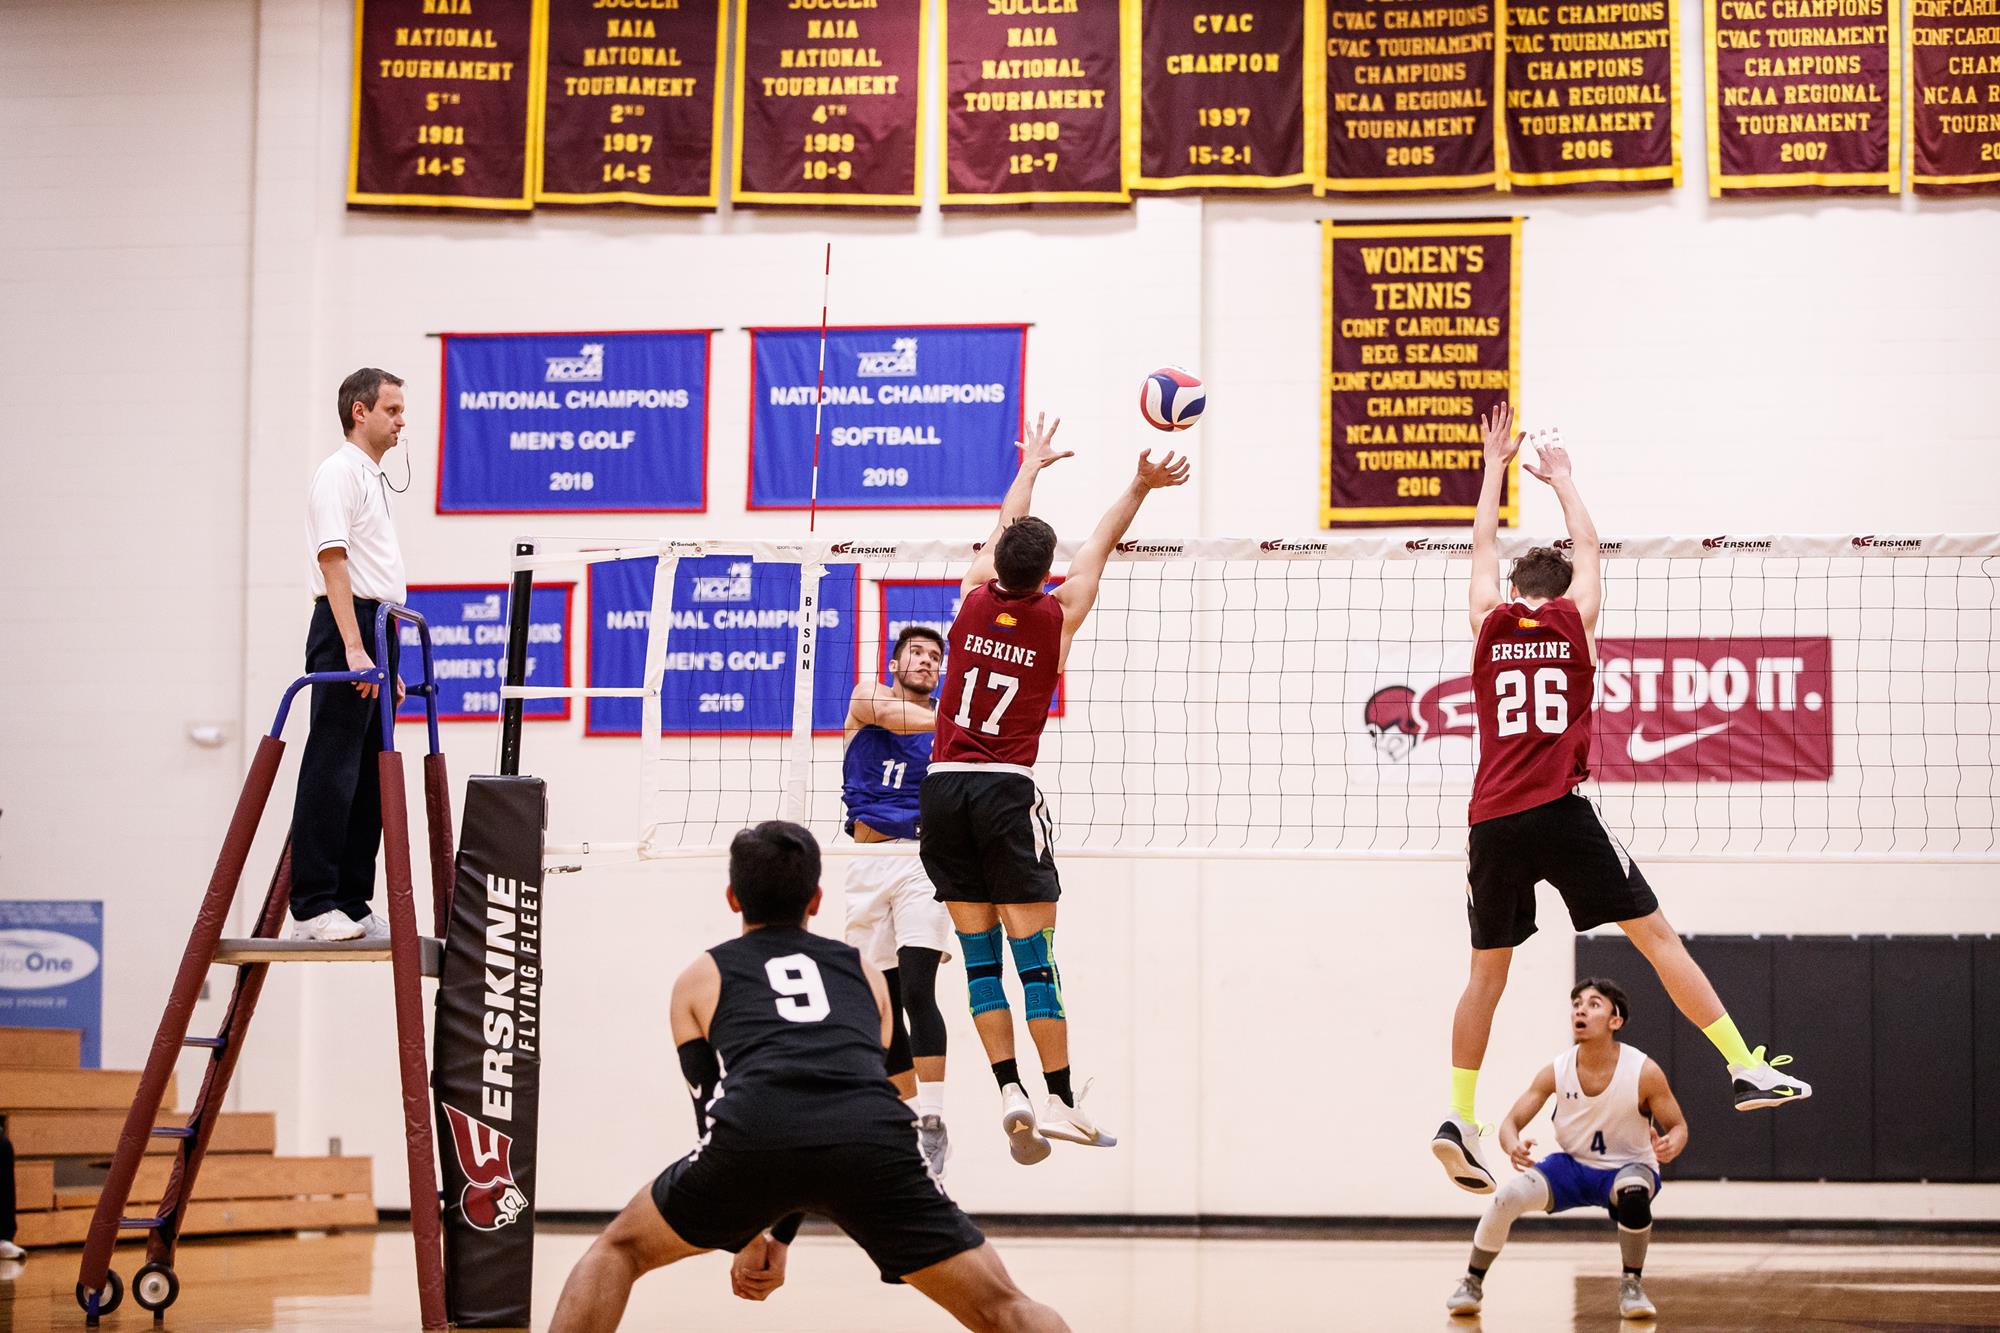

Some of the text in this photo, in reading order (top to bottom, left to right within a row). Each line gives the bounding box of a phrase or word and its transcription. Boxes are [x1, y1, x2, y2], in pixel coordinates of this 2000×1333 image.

[1332, 4, 1489, 31] CVAC CHAMPIONS
[1506, 2, 1664, 26] CVAC CHAMPIONS
[1720, 0, 1883, 20] CVAC CHAMPIONS
[607, 19, 657, 38] NAIA
[807, 20, 859, 39] NAIA
[1193, 13, 1254, 34] CVAC
[395, 28, 497, 48] NATIONAL
[1007, 27, 1058, 47] NAIA
[1327, 32, 1494, 58] CVAC TOURNAMENT
[1550, 28, 1670, 52] TOURNAMENT
[1717, 25, 1887, 49] CVAC TOURNAMENT
[583, 47, 682, 67] NATIONAL
[780, 48, 882, 68] NATIONAL
[1166, 53, 1280, 75] CHAMPION
[1744, 55, 1861, 77] CHAMPIONS
[380, 60, 514, 81] TOURNAMENT
[981, 58, 1085, 80] NATIONAL
[1354, 62, 1467, 85] CHAMPIONS
[1527, 57, 1644, 81] CHAMPIONS
[565, 76, 697, 97] TOURNAMENT
[761, 75, 899, 97] TOURNAMENT
[1507, 83, 1667, 108] NCAA REGIONAL
[1724, 83, 1881, 106] NCAA REGIONAL
[1923, 85, 1978, 105] NCAA
[963, 89, 1106, 113] TOURNAMENT
[1335, 88, 1488, 112] NCAA REGIONAL
[1198, 107, 1251, 127] 1997
[1345, 116, 1476, 139] TOURNAMENT
[1519, 111, 1655, 136] TOURNAMENT
[1736, 112, 1871, 135] TOURNAMENT
[1008, 121, 1060, 142] 1990
[603, 133, 653, 154] 1987
[1562, 140, 1613, 161] 2006
[1780, 141, 1828, 163] 2007
[1009, 152, 1058, 175] 12-7
[1189, 145, 1252, 165] 15-2-1
[1386, 146, 1435, 166] 2005
[416, 157, 465, 176] 14-5
[602, 163, 651, 184] 14-5
[1361, 246, 1484, 274] WOMEN'S
[1371, 282, 1472, 311] TENNIS
[1395, 317, 1500, 337] CAROLINAS
[1405, 343, 1478, 364] SEASON
[460, 389, 689, 411] NATIONAL CHAMPIONS
[770, 383, 1005, 406] NATIONAL CHAMPIONS
[1367, 397, 1474, 417] CHAMPIONS
[510, 430, 636, 451] MEN'S GOLF
[831, 426, 942, 447] SOFTBALL
[1346, 425, 1398, 445] NCAA
[1356, 449, 1482, 471] TOURNAMENT
[549, 472, 594, 491] 2018
[862, 468, 909, 487] 2019
[1397, 477, 1441, 497] 2016
[1427, 543, 1473, 551] ERSKINE
[1600, 542, 1622, 550] KINE
[1724, 541, 1772, 549] ERSKINE
[606, 609, 840, 630] NATINAL CHAMPIS
[802, 596, 812, 670] BISON
[727, 651, 786, 670] GOLF
[964, 634, 1037, 668] ERSKINE
[1491, 641, 1571, 662] ERSKINE
[1591, 656, 1822, 712] ST DO IT.
[698, 693, 745, 712] 2019
[954, 667, 1020, 736] 17
[1495, 667, 1568, 737] 26
[882, 759, 908, 789] 11
[518, 884, 538, 1052] FLYING FLEET
[482, 873, 516, 1121] ERSKINE
[764, 952, 831, 1023] 9
[1590, 1130, 1607, 1156] 4
